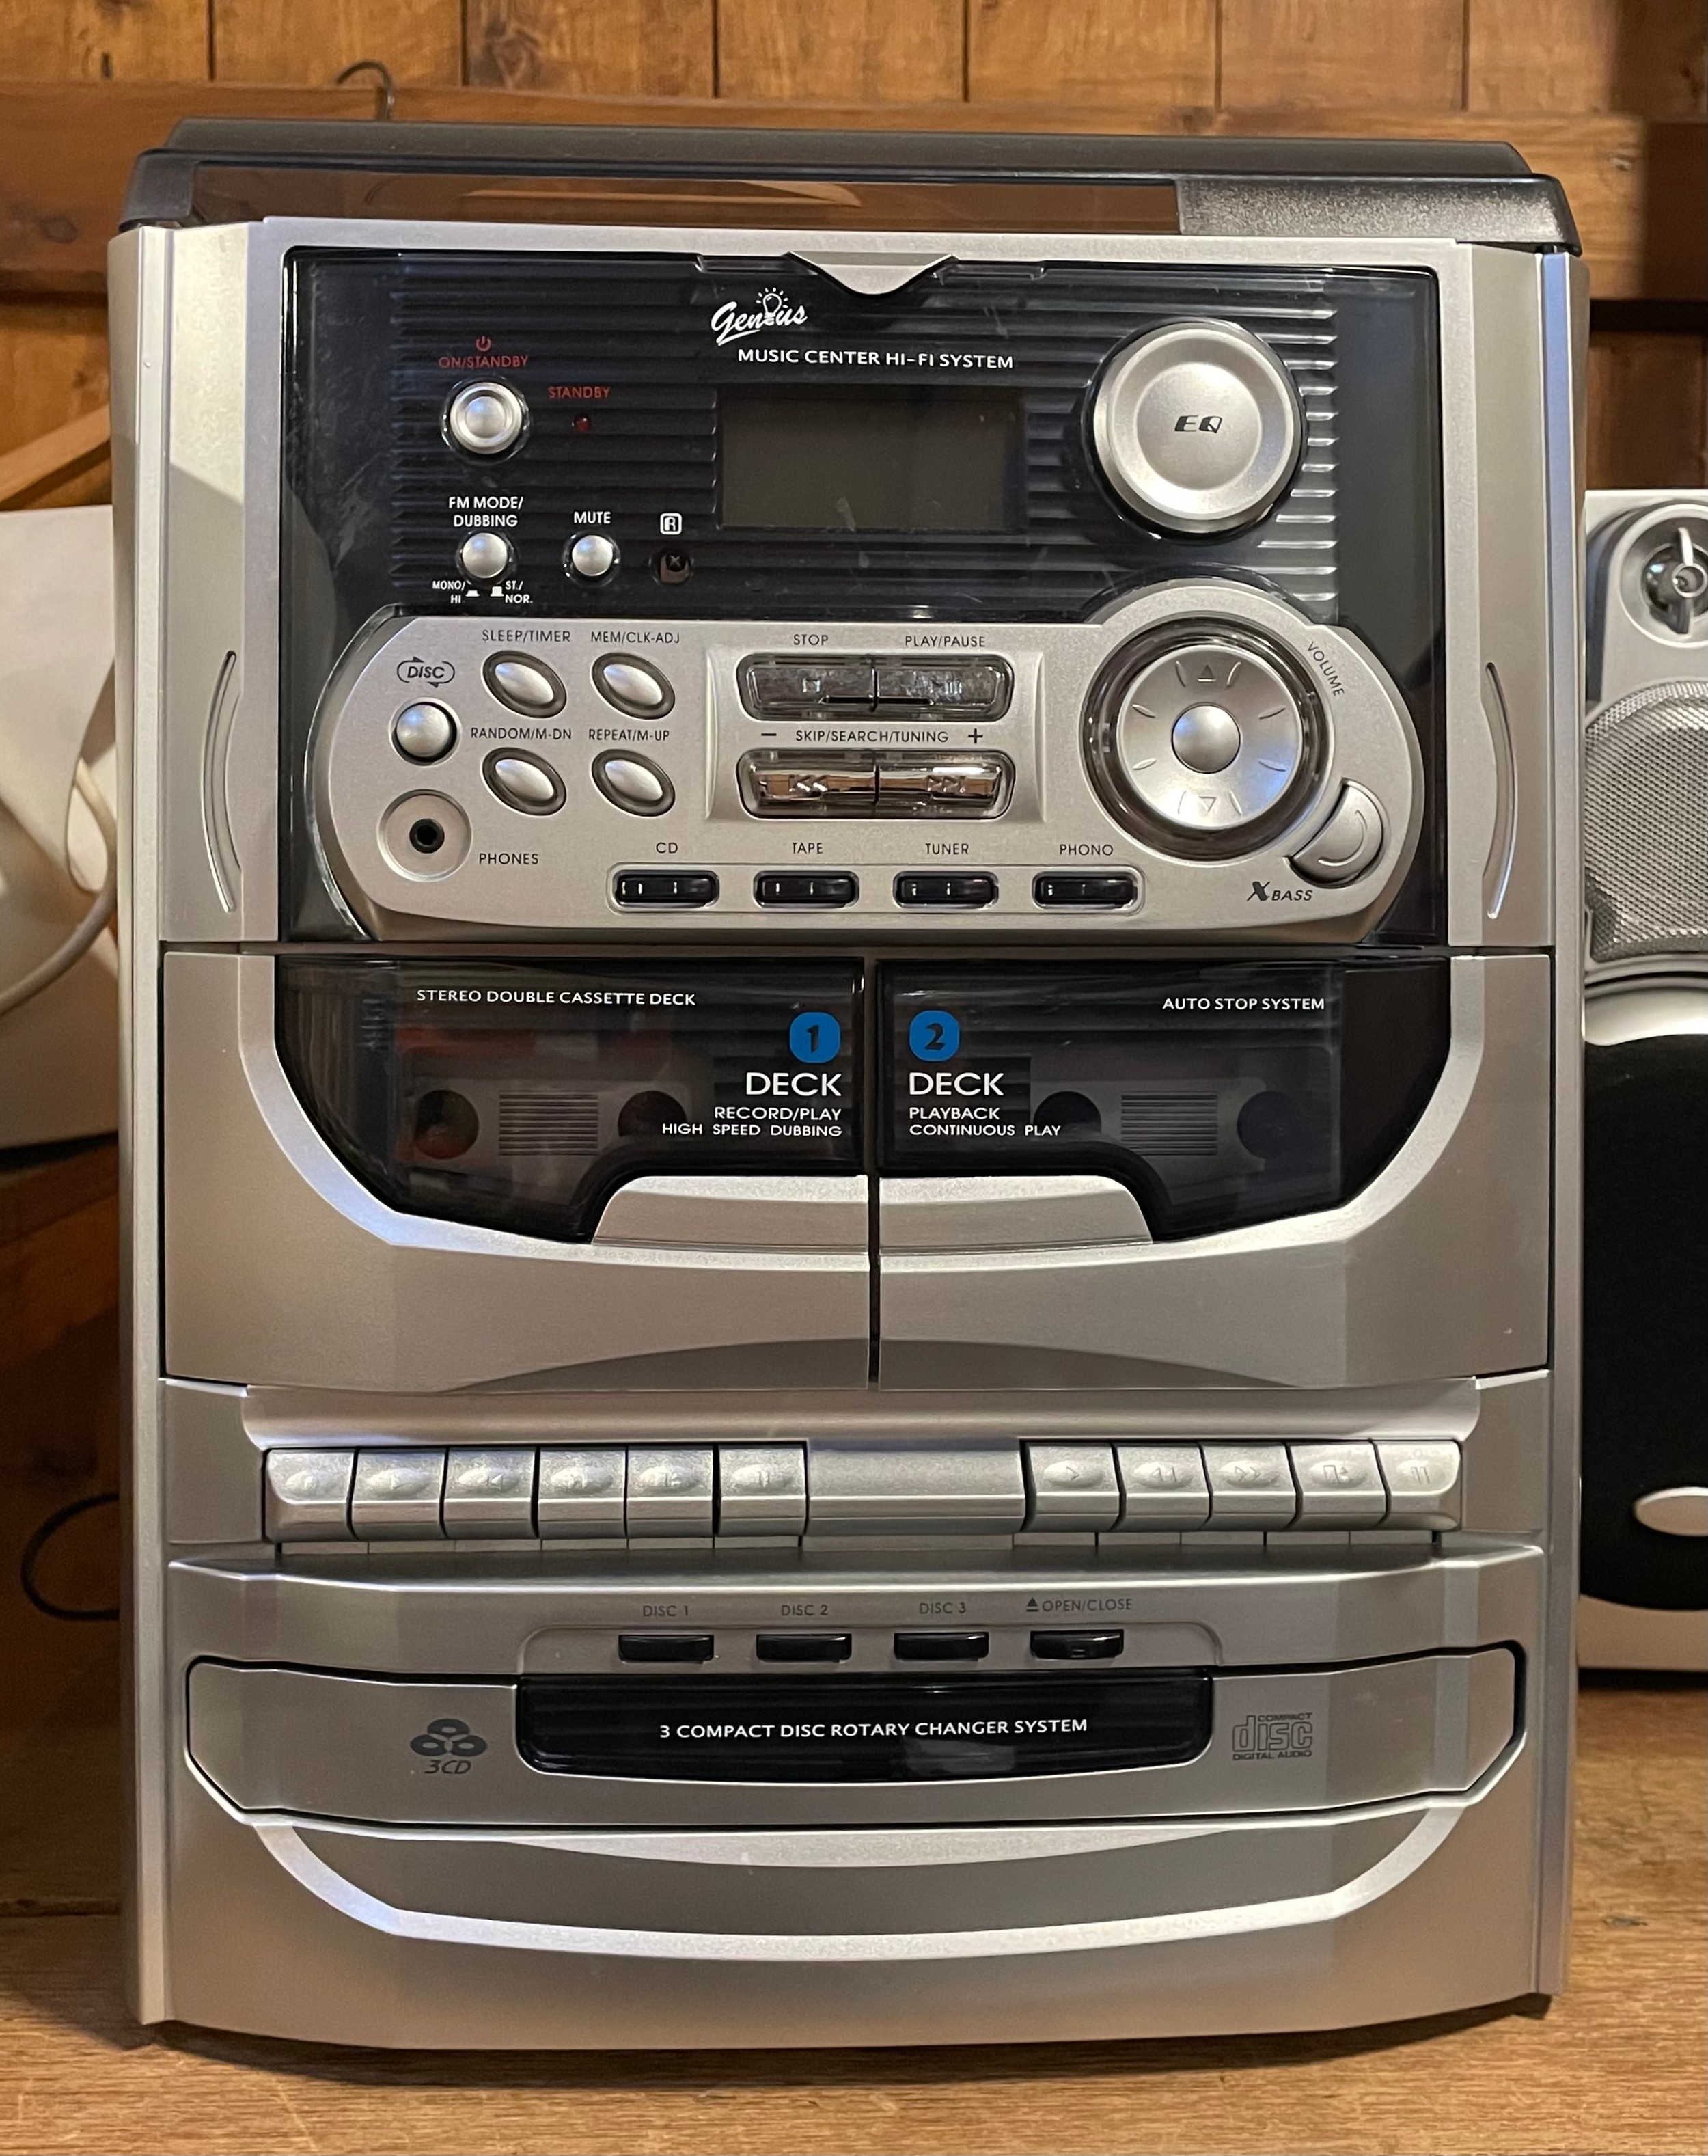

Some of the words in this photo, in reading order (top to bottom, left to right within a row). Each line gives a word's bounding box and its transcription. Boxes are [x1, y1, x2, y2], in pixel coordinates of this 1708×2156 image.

[439, 355, 528, 368] ON/STANDBY
[737, 348, 799, 364] MUSIC
[803, 349, 881, 367] CENTER
[885, 351, 935, 368] HI-FI
[939, 353, 1015, 370] SYSTEM
[548, 387, 611, 399] STANDBY
[1174, 415, 1223, 434] EQ
[448, 497, 470, 510] FM
[473, 496, 524, 510] MODE/
[453, 514, 519, 528] DUBBING
[573, 511, 611, 525] MUTE
[432, 580, 465, 592] MONO/
[481, 629, 571, 643] SLEEP/TIMER
[590, 631, 680, 645] MEM/CLK-ADJ
[793, 633, 829, 646] STOP
[905, 635, 986, 648] PLAY/PAUSE
[407, 666, 446, 680] DISC
[1306, 641, 1345, 698] VOLUME
[471, 727, 573, 741] RANDOM/M-DN
[588, 728, 670, 742] REPEAT/M-UP
[795, 729, 949, 743] SKIP/SEARCH/TUNING
[655, 842, 678, 854] CD
[792, 841, 824, 855] TAPE
[925, 843, 969, 856] TUNER
[1058, 843, 1114, 857] PHONO
[478, 852, 539, 866] PHONES
[416, 989, 482, 1003] STEREO
[486, 990, 555, 1005] DOUBLE
[558, 991, 645, 1006] CASSETTE
[650, 992, 697, 1007] DECK
[1162, 998, 1211, 1011] AUTO
[1214, 997, 1258, 1011] STOP
[1261, 998, 1325, 1011] SYSTEM
[806, 1025, 820, 1053] 1
[924, 1023, 946, 1051] 2
[745, 1072, 842, 1097] DECK
[908, 1072, 1004, 1097] DECK
[713, 1106, 842, 1122] RECORD/PLAY
[909, 1106, 1000, 1121] PLAYBACK
[661, 1123, 704, 1136] HIGH
[712, 1123, 762, 1136] SPEED
[769, 1124, 843, 1138] DUBBING
[909, 1124, 1016, 1137] CONTINUOUS
[1024, 1125, 1062, 1137] PLAY
[642, 1605, 678, 1617] DISC
[683, 1605, 689, 1617] 1
[780, 1604, 816, 1616] DISC
[819, 1604, 829, 1616] 2
[919, 1602, 952, 1615] DISC
[958, 1602, 967, 1615] 3
[1042, 1598, 1133, 1613] OPEN/CLOSE
[1258, 1712, 1313, 1722] COMPACT
[660, 1725, 671, 1739] 3
[676, 1724, 775, 1739] COMPACT
[780, 1723, 825, 1738] DISC
[831, 1723, 909, 1738] ROTARY
[915, 1721, 1009, 1736] CHANGER
[1013, 1719, 1088, 1734] SYSTEM
[1232, 1752, 1274, 1760] DIGITAL
